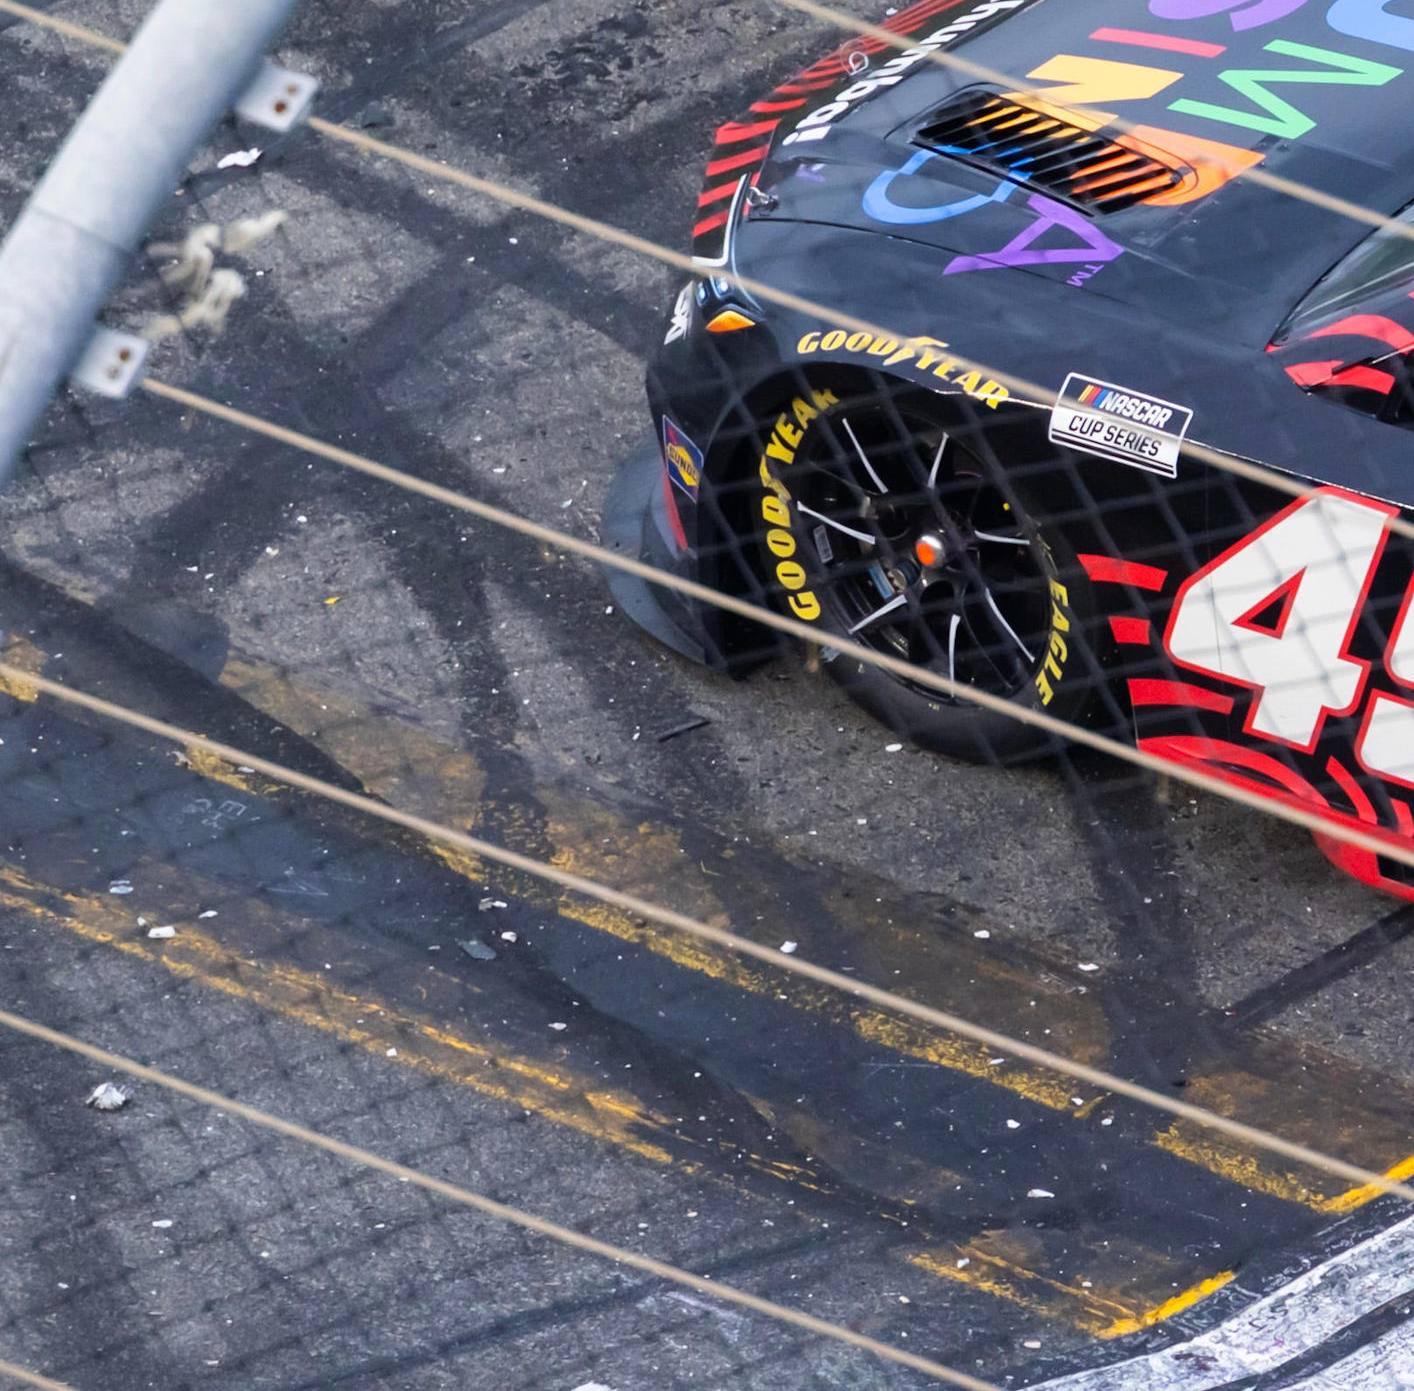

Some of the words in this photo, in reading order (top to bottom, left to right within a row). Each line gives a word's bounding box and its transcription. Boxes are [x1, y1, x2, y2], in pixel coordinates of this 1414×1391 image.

[796, 329, 1010, 410] GOODYEAR
[1098, 390, 1173, 429] NASCAR
[1068, 414, 1105, 438] CUP
[1103, 424, 1163, 458] SERIES
[758, 386, 840, 622] GOODYEAR
[1032, 577, 1071, 707] EAGLE
